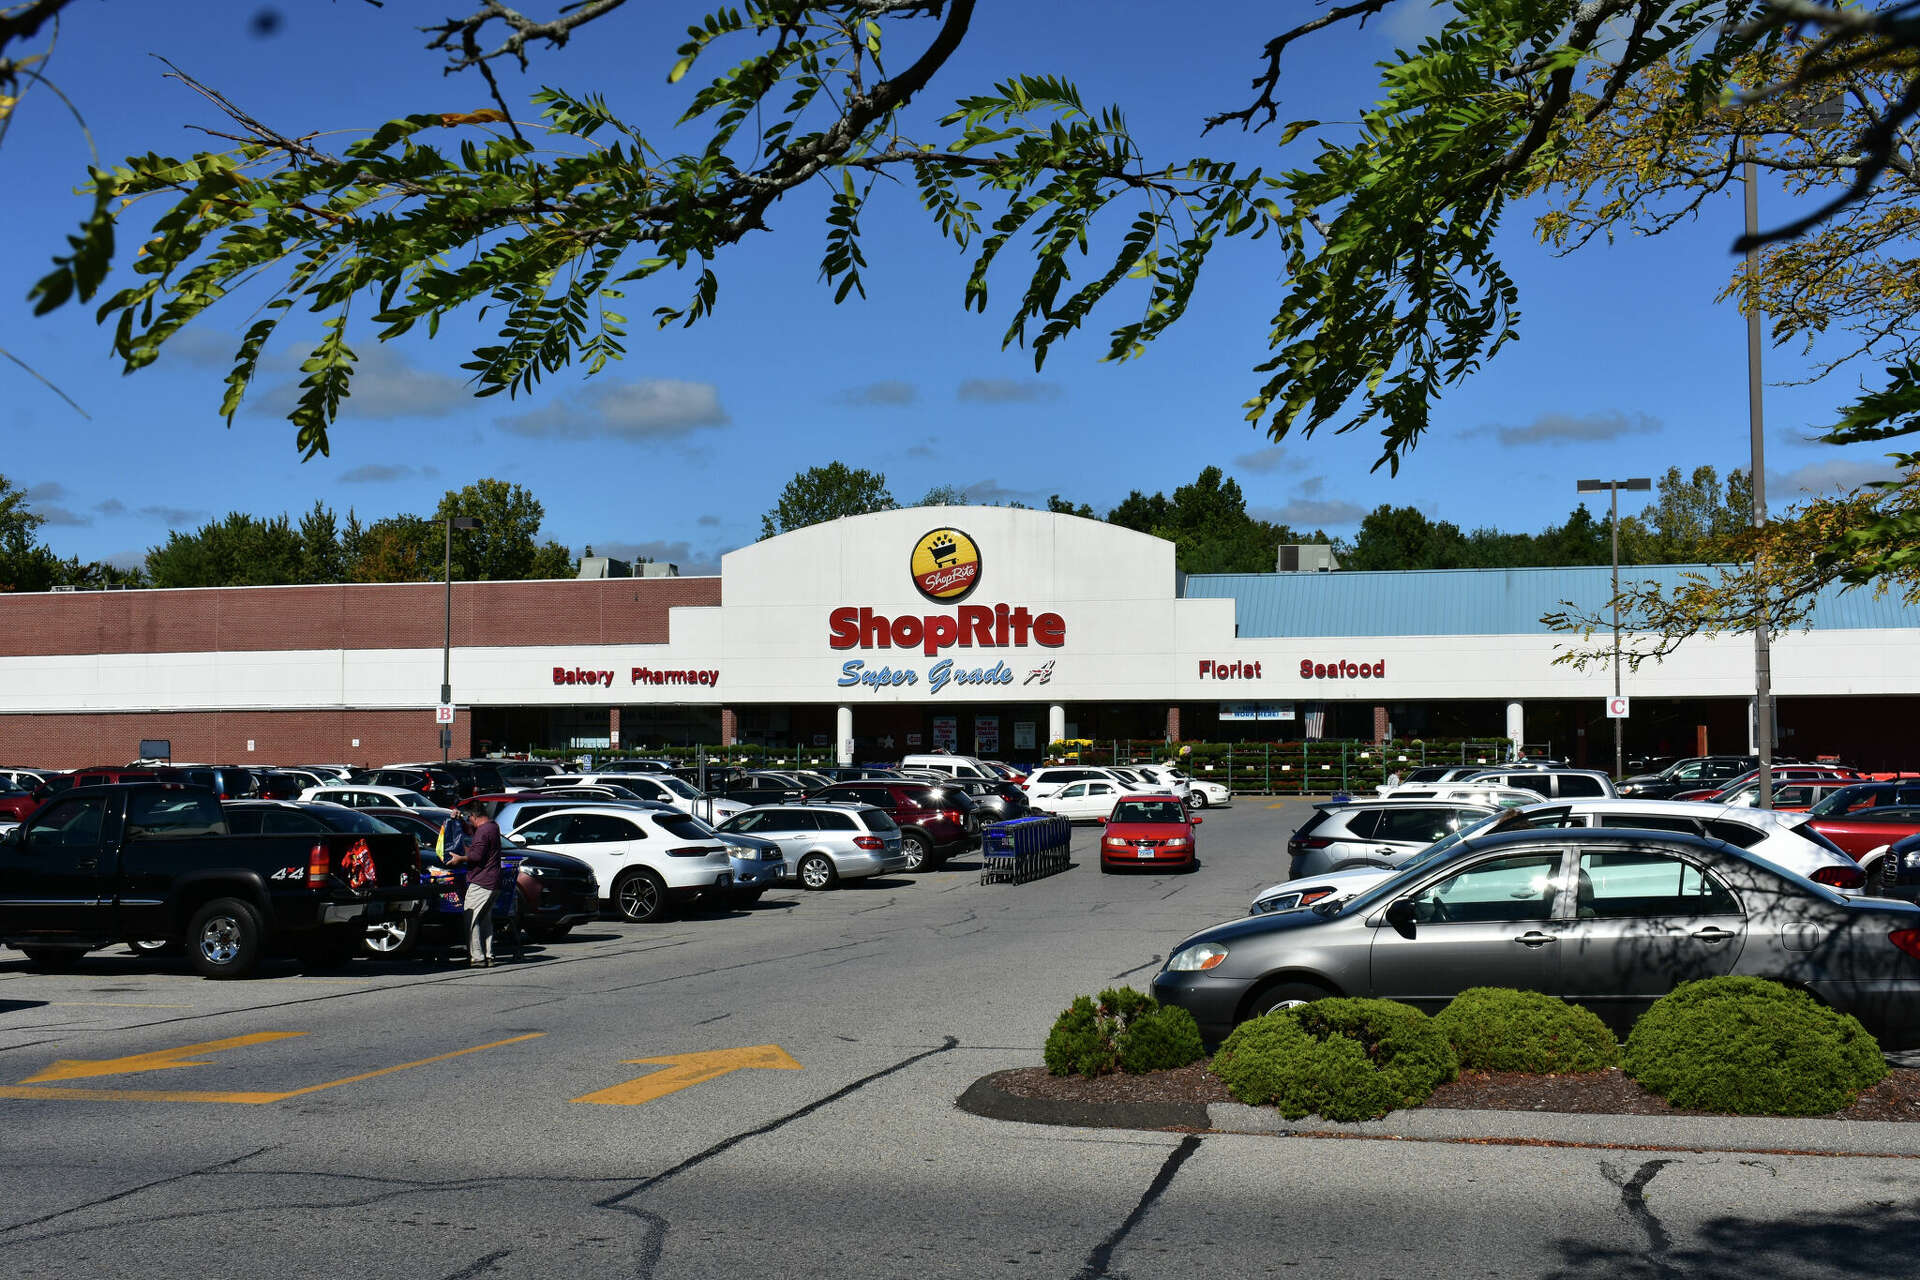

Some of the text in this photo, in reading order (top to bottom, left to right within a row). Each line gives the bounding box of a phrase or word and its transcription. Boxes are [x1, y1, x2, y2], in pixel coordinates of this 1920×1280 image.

[925, 565, 975, 591] ShopRite
[829, 603, 1066, 656] ShopRite
[552, 667, 615, 687] Bakery
[631, 667, 719, 687] Pharmacy
[837, 659, 918, 693] Super
[927, 658, 1014, 694] Grade
[1199, 660, 1262, 680] Florist
[1300, 659, 1385, 680] Seafood
[439, 707, 452, 720] B
[1610, 699, 1625, 715] C
